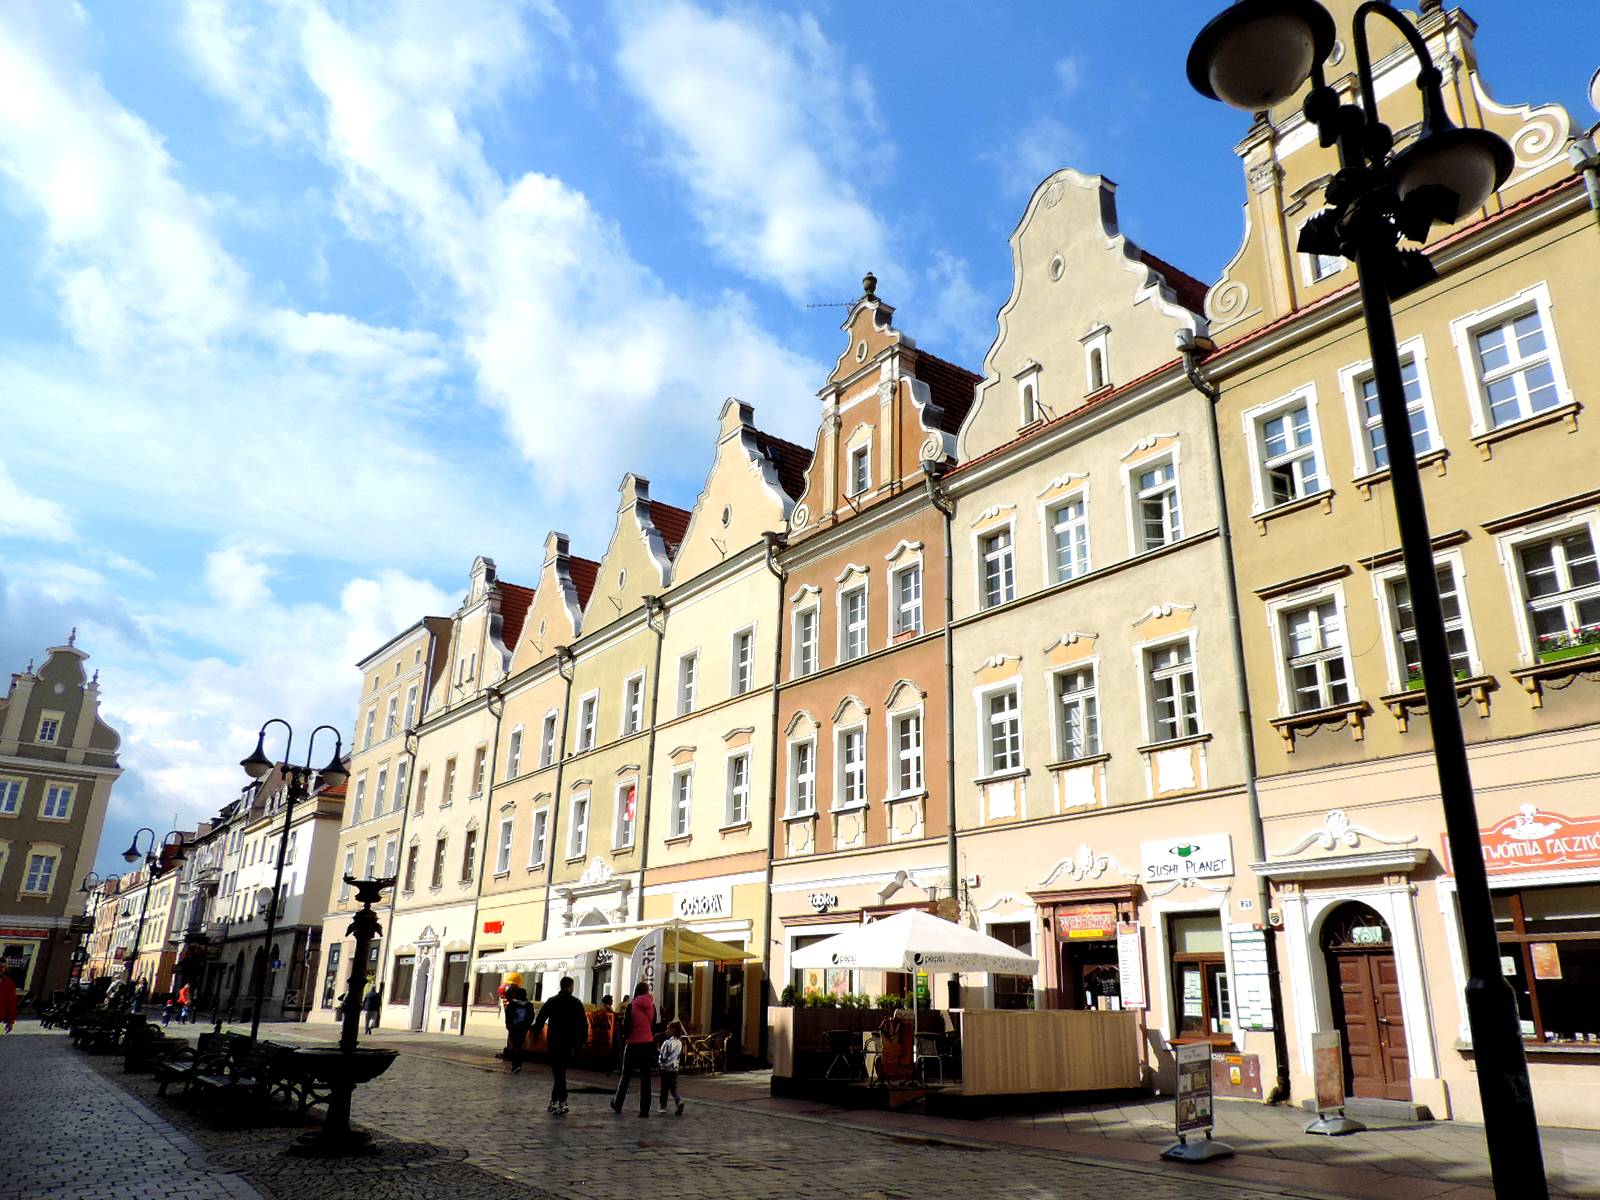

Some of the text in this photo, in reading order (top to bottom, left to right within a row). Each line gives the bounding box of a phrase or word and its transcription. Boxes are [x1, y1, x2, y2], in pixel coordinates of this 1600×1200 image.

[1482, 832, 1600, 860] TWÓRNIA PĄCZKÓ
[1147, 859, 1226, 877] SUSHI PLANET
